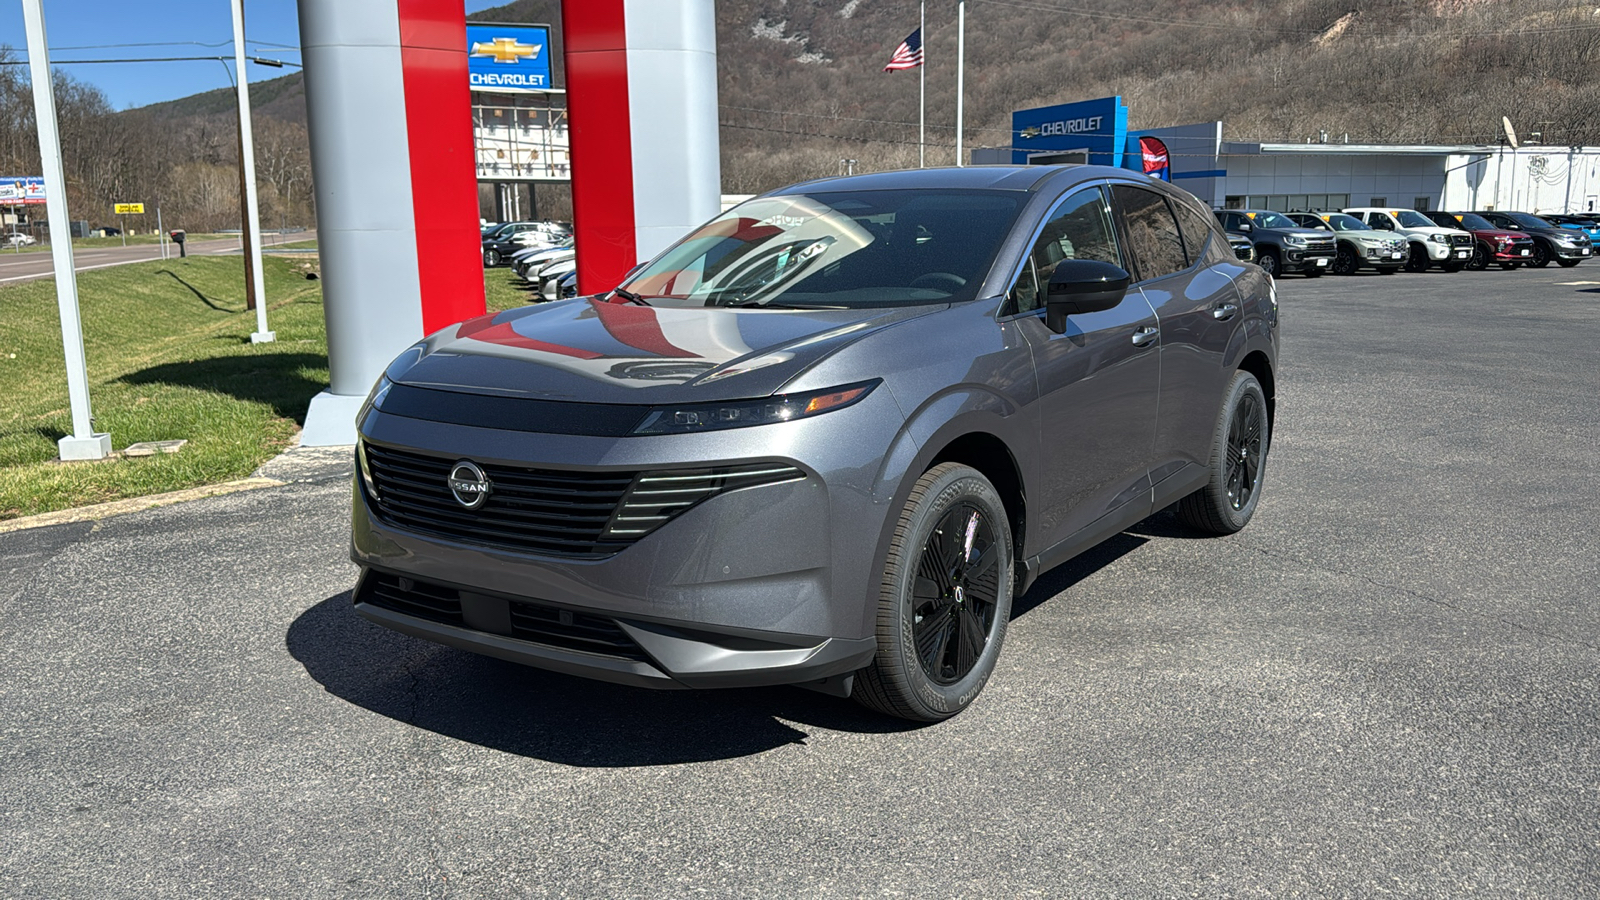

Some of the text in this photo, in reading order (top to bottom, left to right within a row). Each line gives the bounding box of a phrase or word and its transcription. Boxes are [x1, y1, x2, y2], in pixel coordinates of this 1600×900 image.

[469, 73, 545, 85] CHEVROLET
[1041, 116, 1103, 136] CHEVROLET
[958, 671, 988, 705] KUMHO
